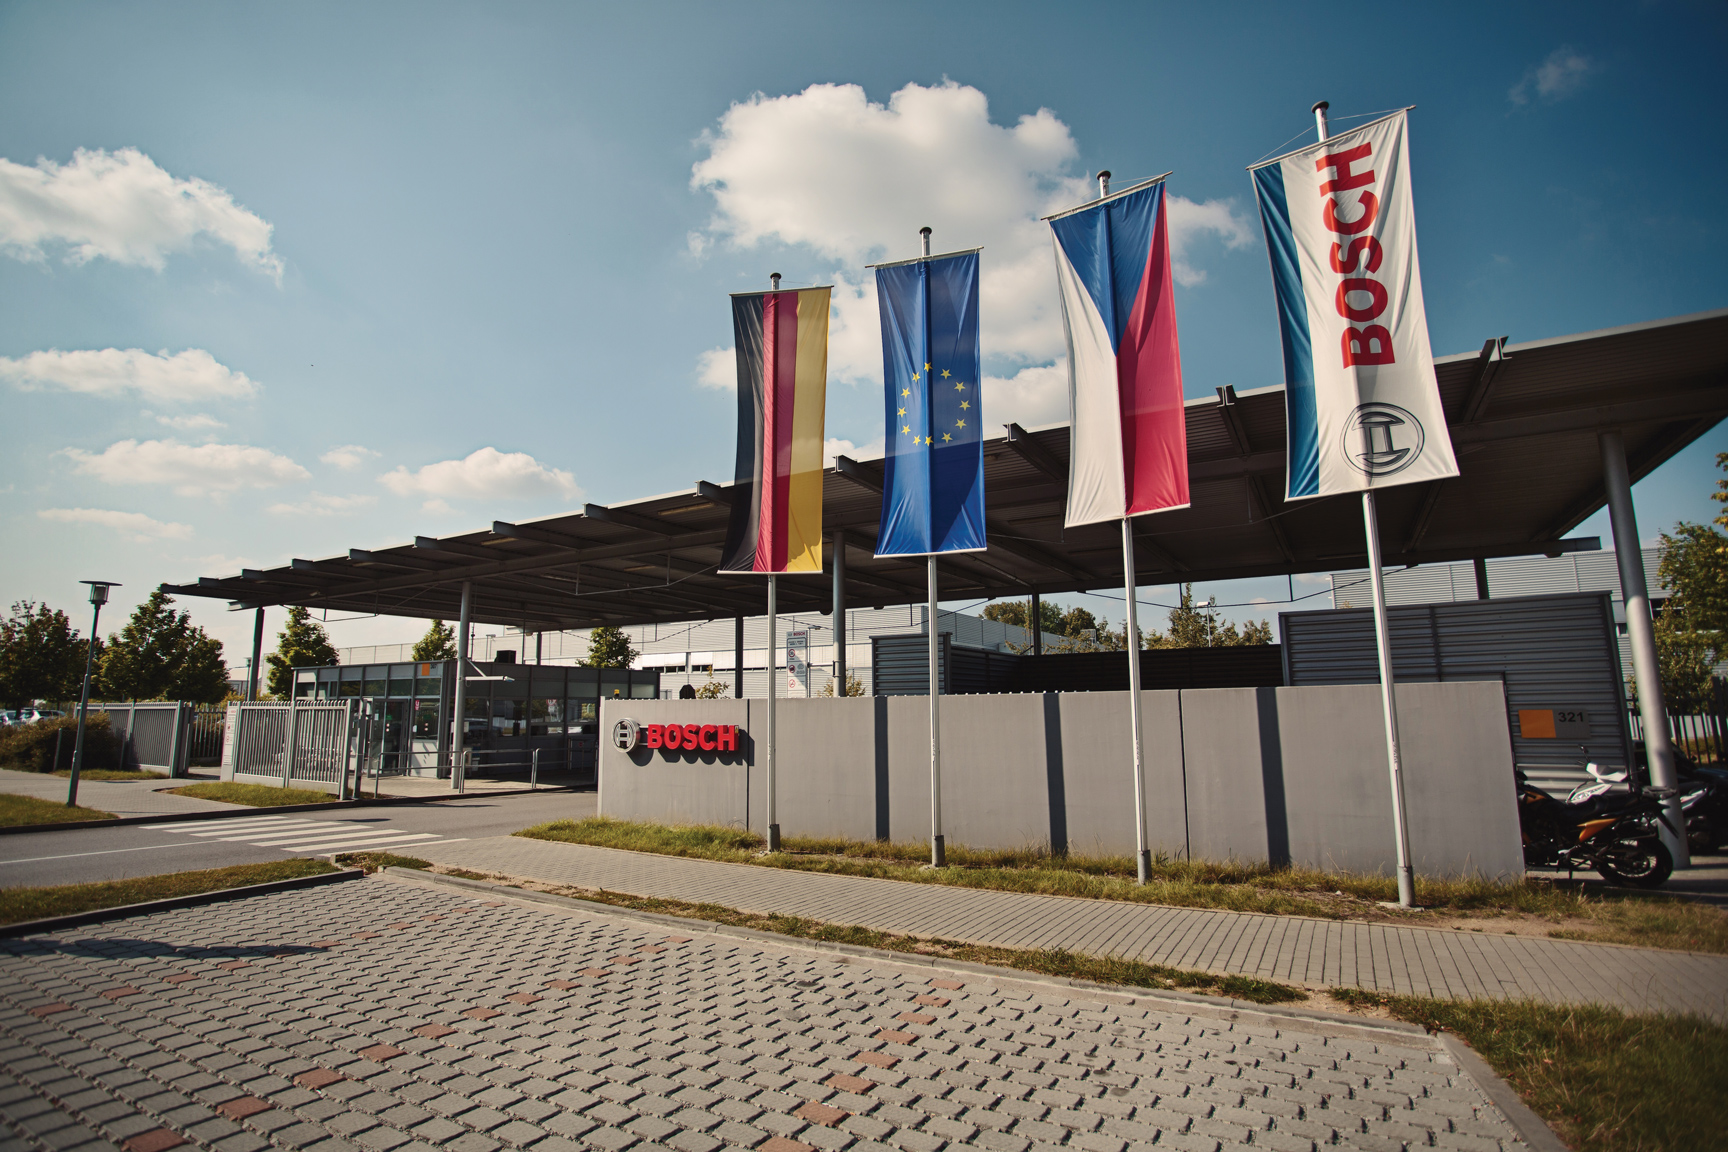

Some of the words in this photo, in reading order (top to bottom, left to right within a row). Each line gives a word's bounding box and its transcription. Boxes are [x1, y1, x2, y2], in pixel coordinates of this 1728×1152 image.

[1315, 141, 1396, 370] BOSCH
[1557, 711, 1584, 723] 321
[647, 723, 737, 751] BOSCH
